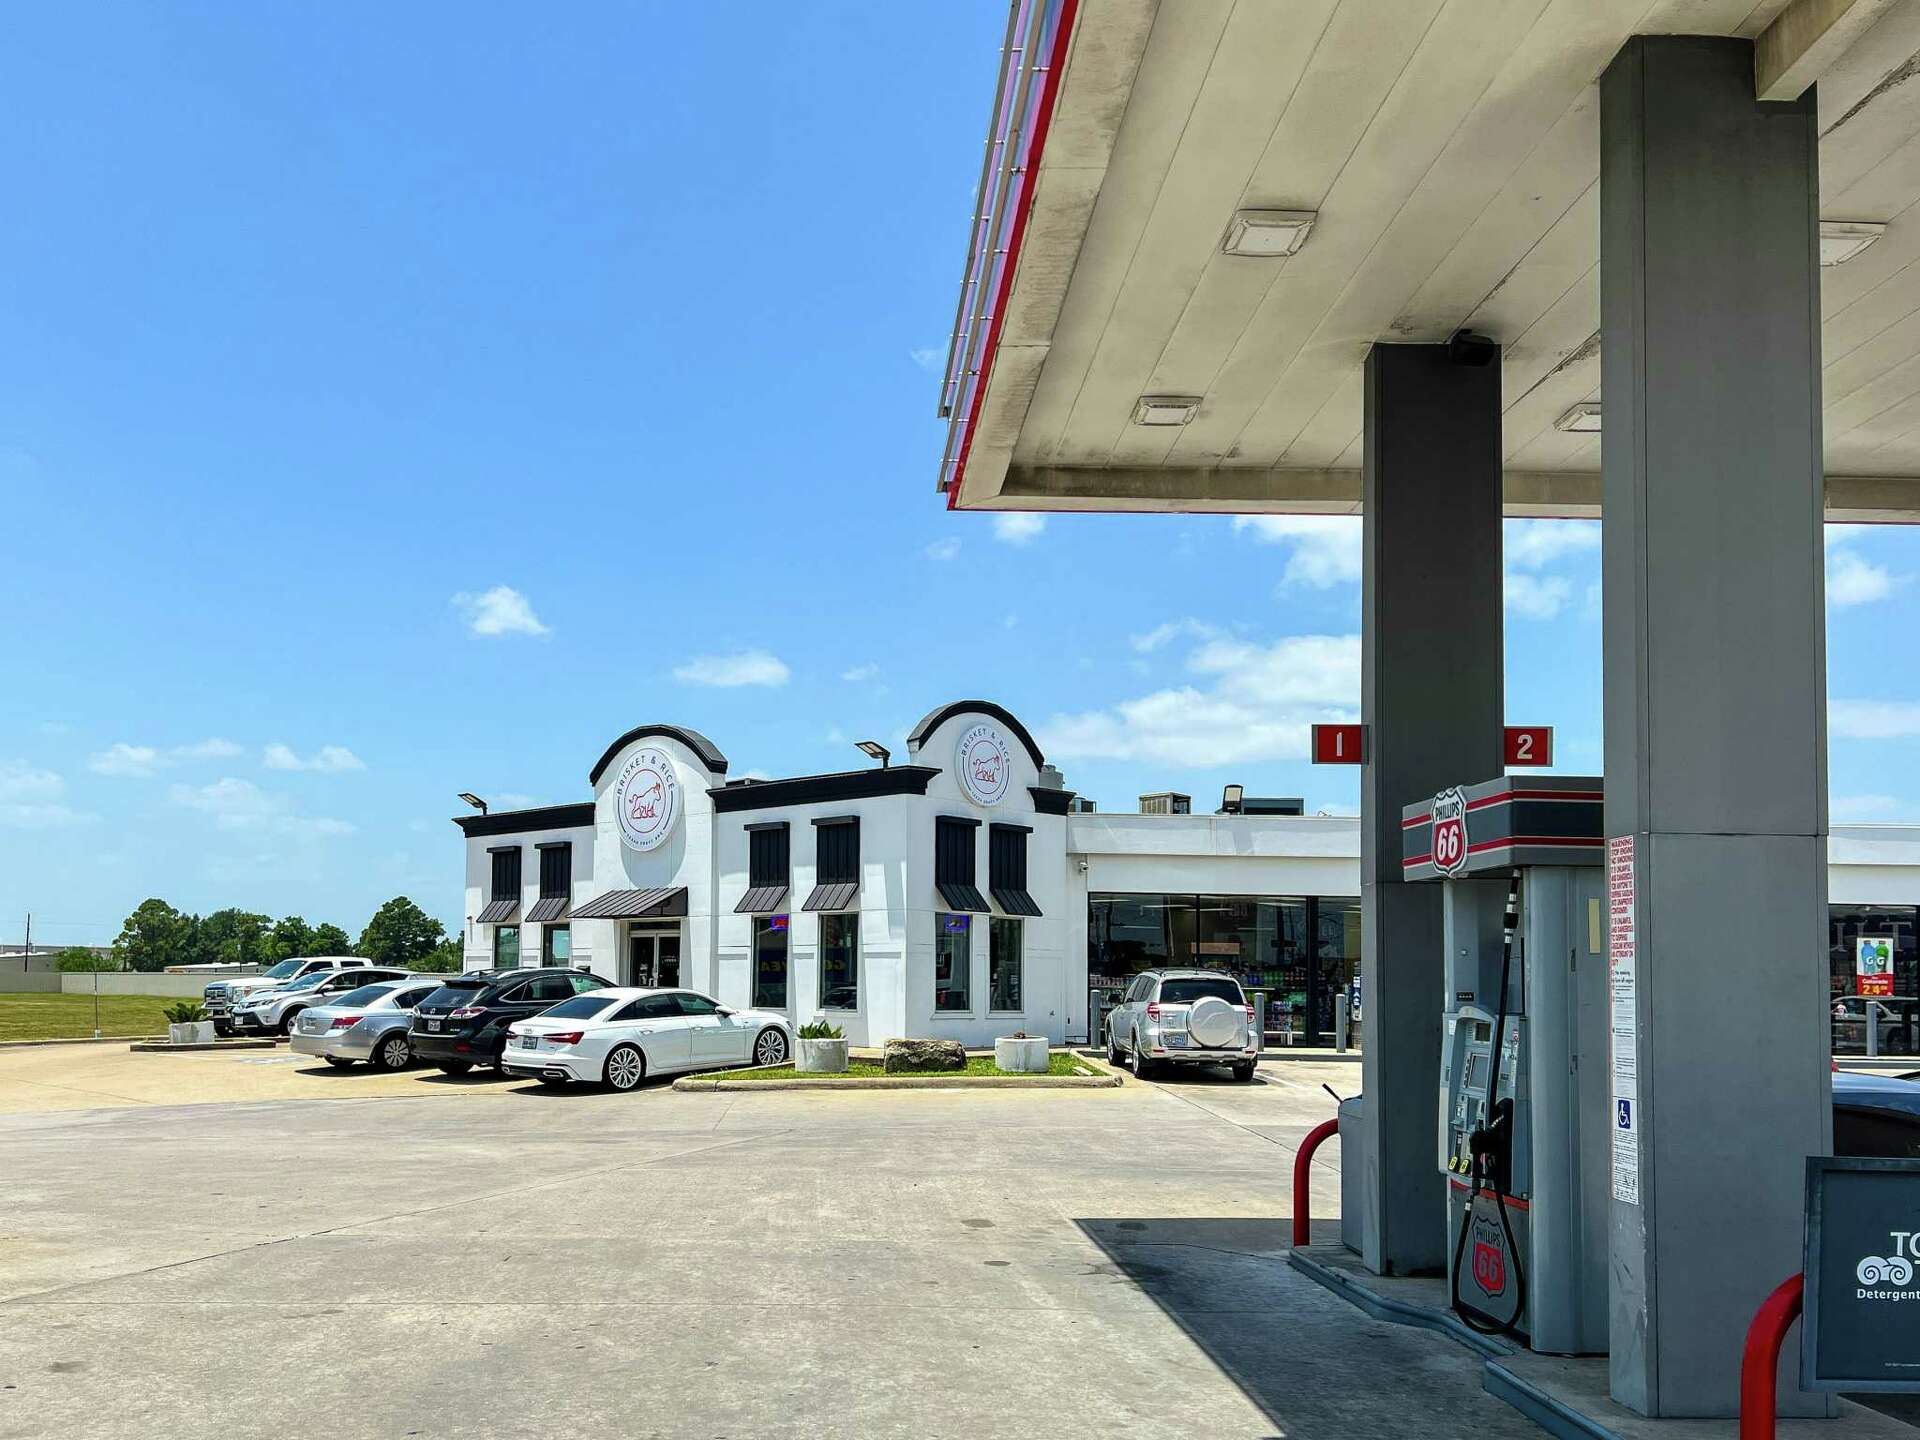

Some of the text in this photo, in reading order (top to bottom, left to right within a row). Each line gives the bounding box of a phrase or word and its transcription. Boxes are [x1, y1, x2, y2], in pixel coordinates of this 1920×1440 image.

[961, 728, 986, 756] BRISKET
[1336, 732, 1342, 757] 1
[1517, 734, 1533, 760] 2
[616, 755, 675, 795] BRISKET & RICE
[1436, 801, 1460, 821] PHILLIPS
[1437, 824, 1460, 861] 66
[1475, 1226, 1501, 1248] PHILLIPS
[1479, 1250, 1499, 1284] 66
[1856, 1288, 1920, 1302] Detergent
